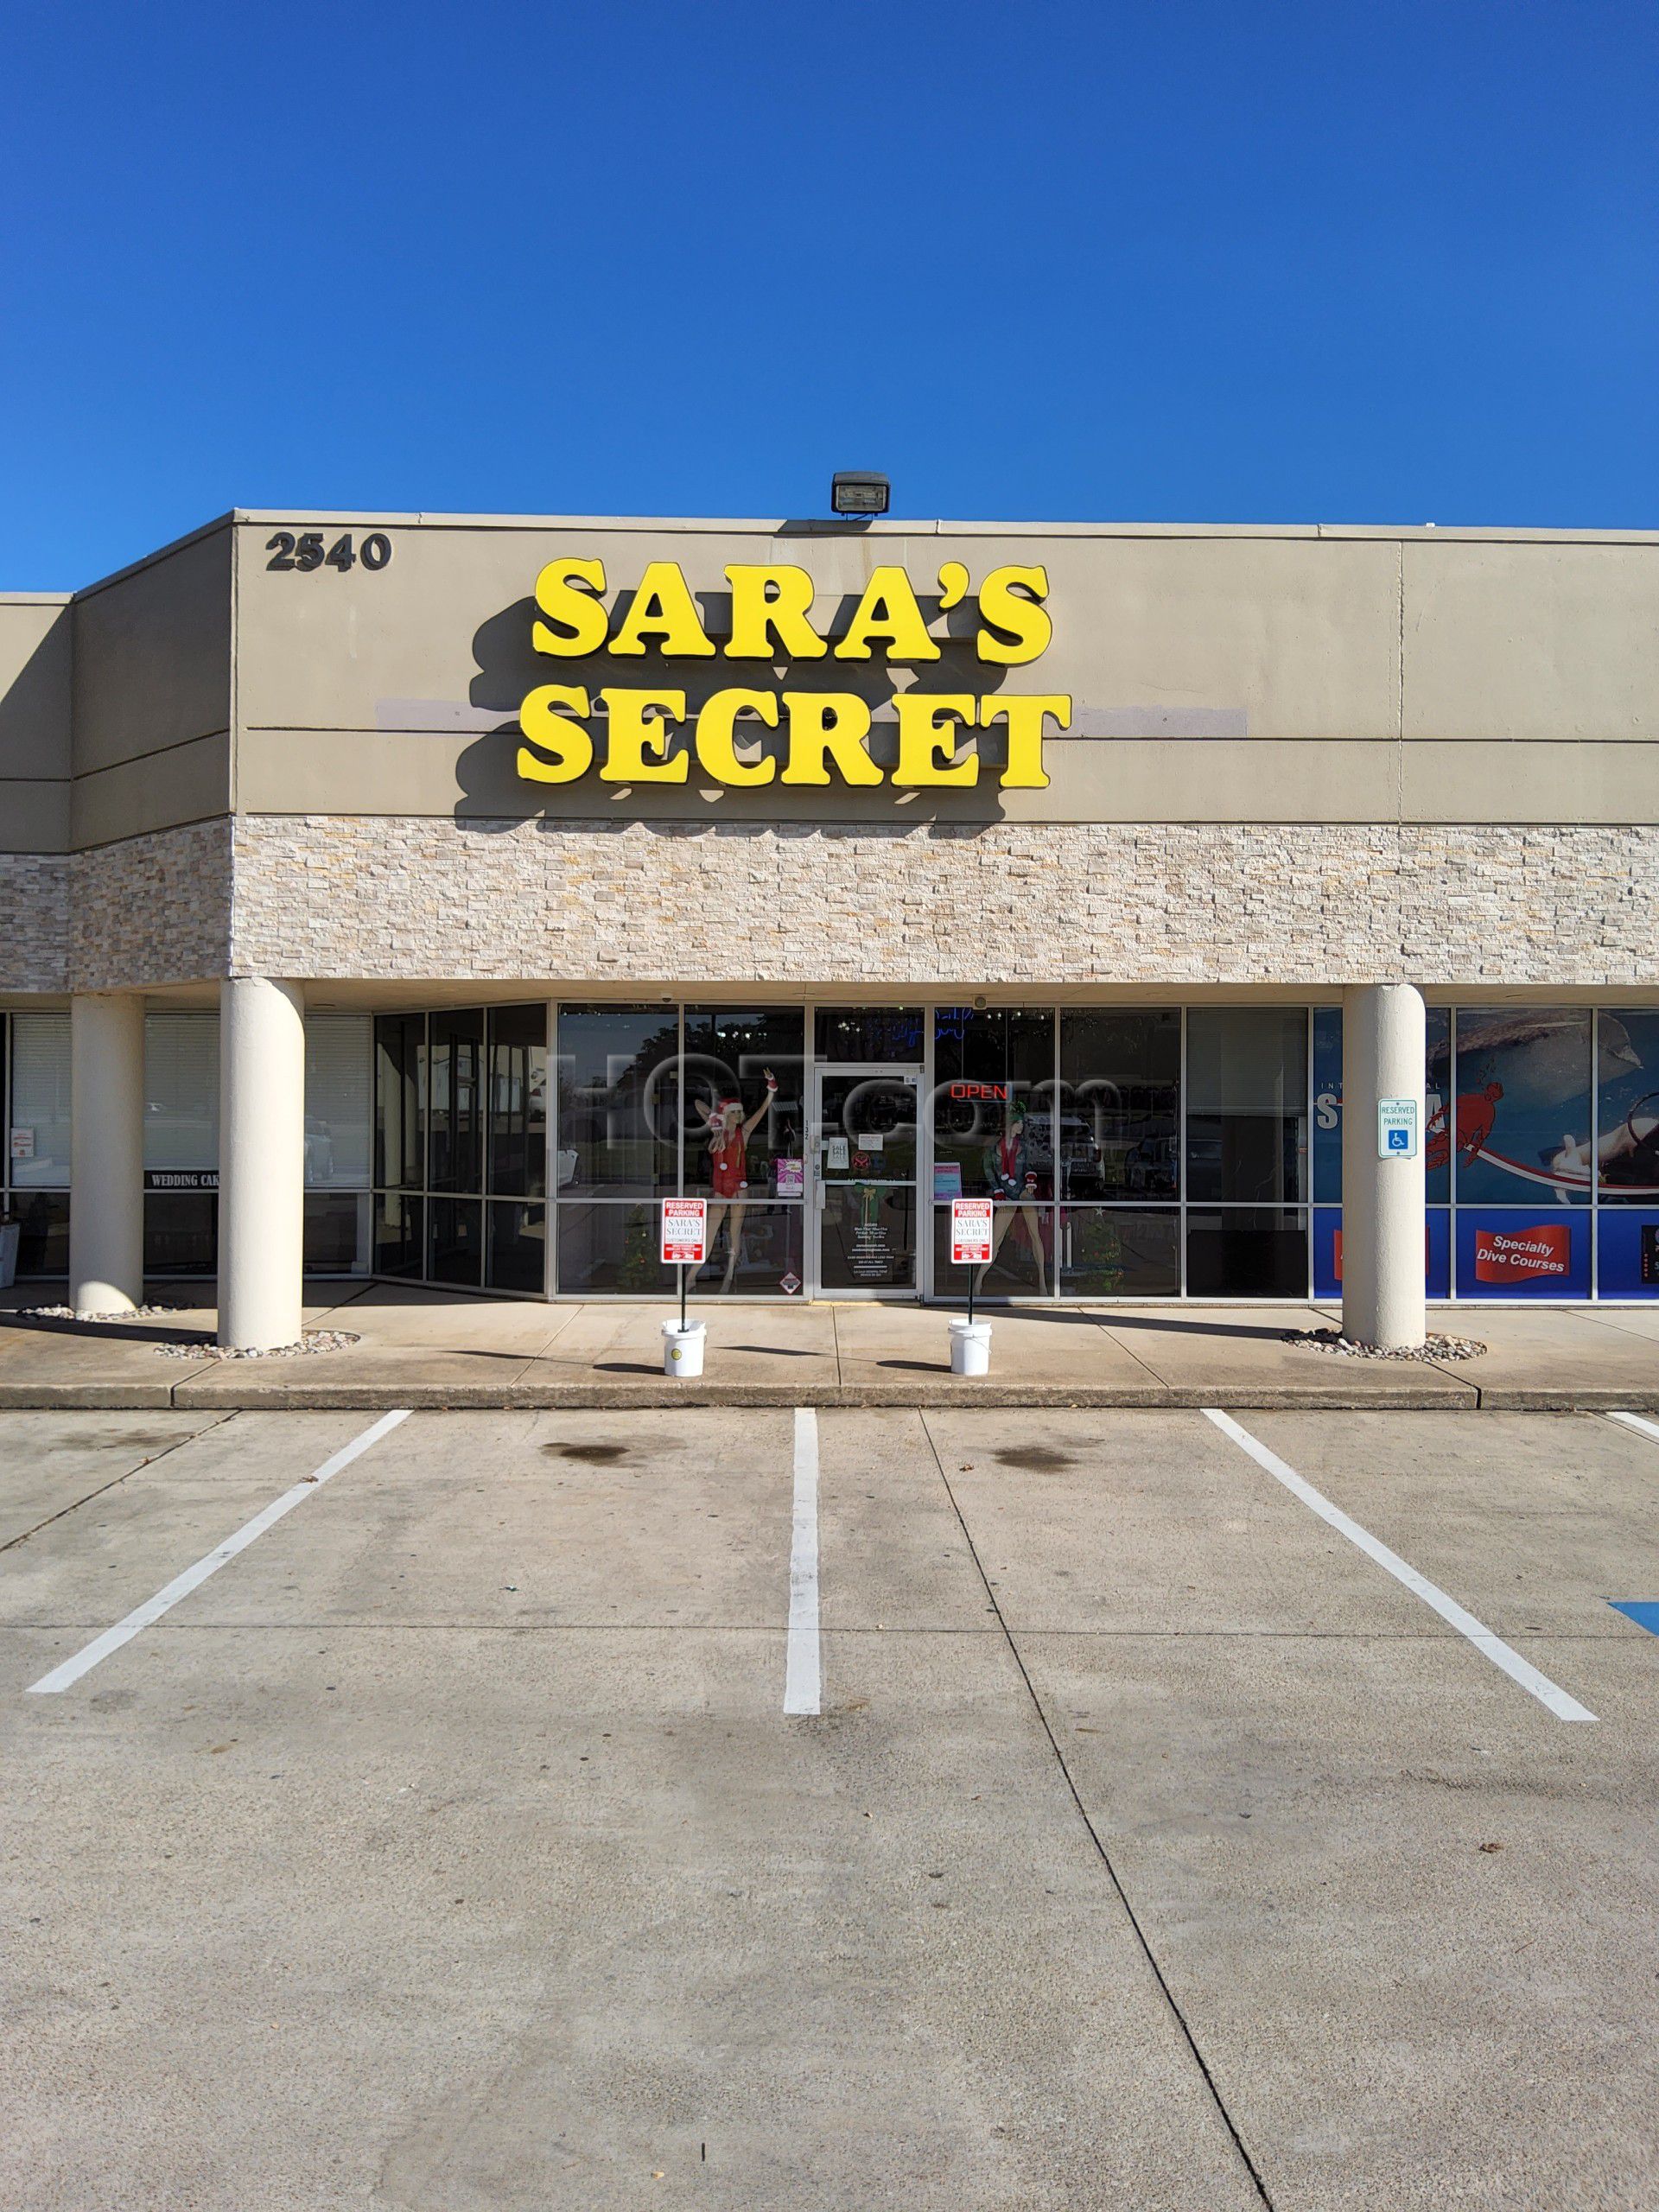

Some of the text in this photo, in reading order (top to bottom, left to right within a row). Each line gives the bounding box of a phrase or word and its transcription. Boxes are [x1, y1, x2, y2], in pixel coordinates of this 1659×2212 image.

[264, 531, 392, 572] 2540
[531, 557, 1053, 665] SARA'S
[517, 683, 1073, 788] SECRET
[951, 1084, 1007, 1100] OPEN
[1382, 1106, 1414, 1115] RESERVED
[1383, 1117, 1413, 1126] PARKING
[151, 1174, 198, 1186] WEDDING
[668, 1218, 700, 1227] SARA'S
[1493, 1236, 1554, 1257] Specialty
[1477, 1249, 1565, 1272] Dive Courses
